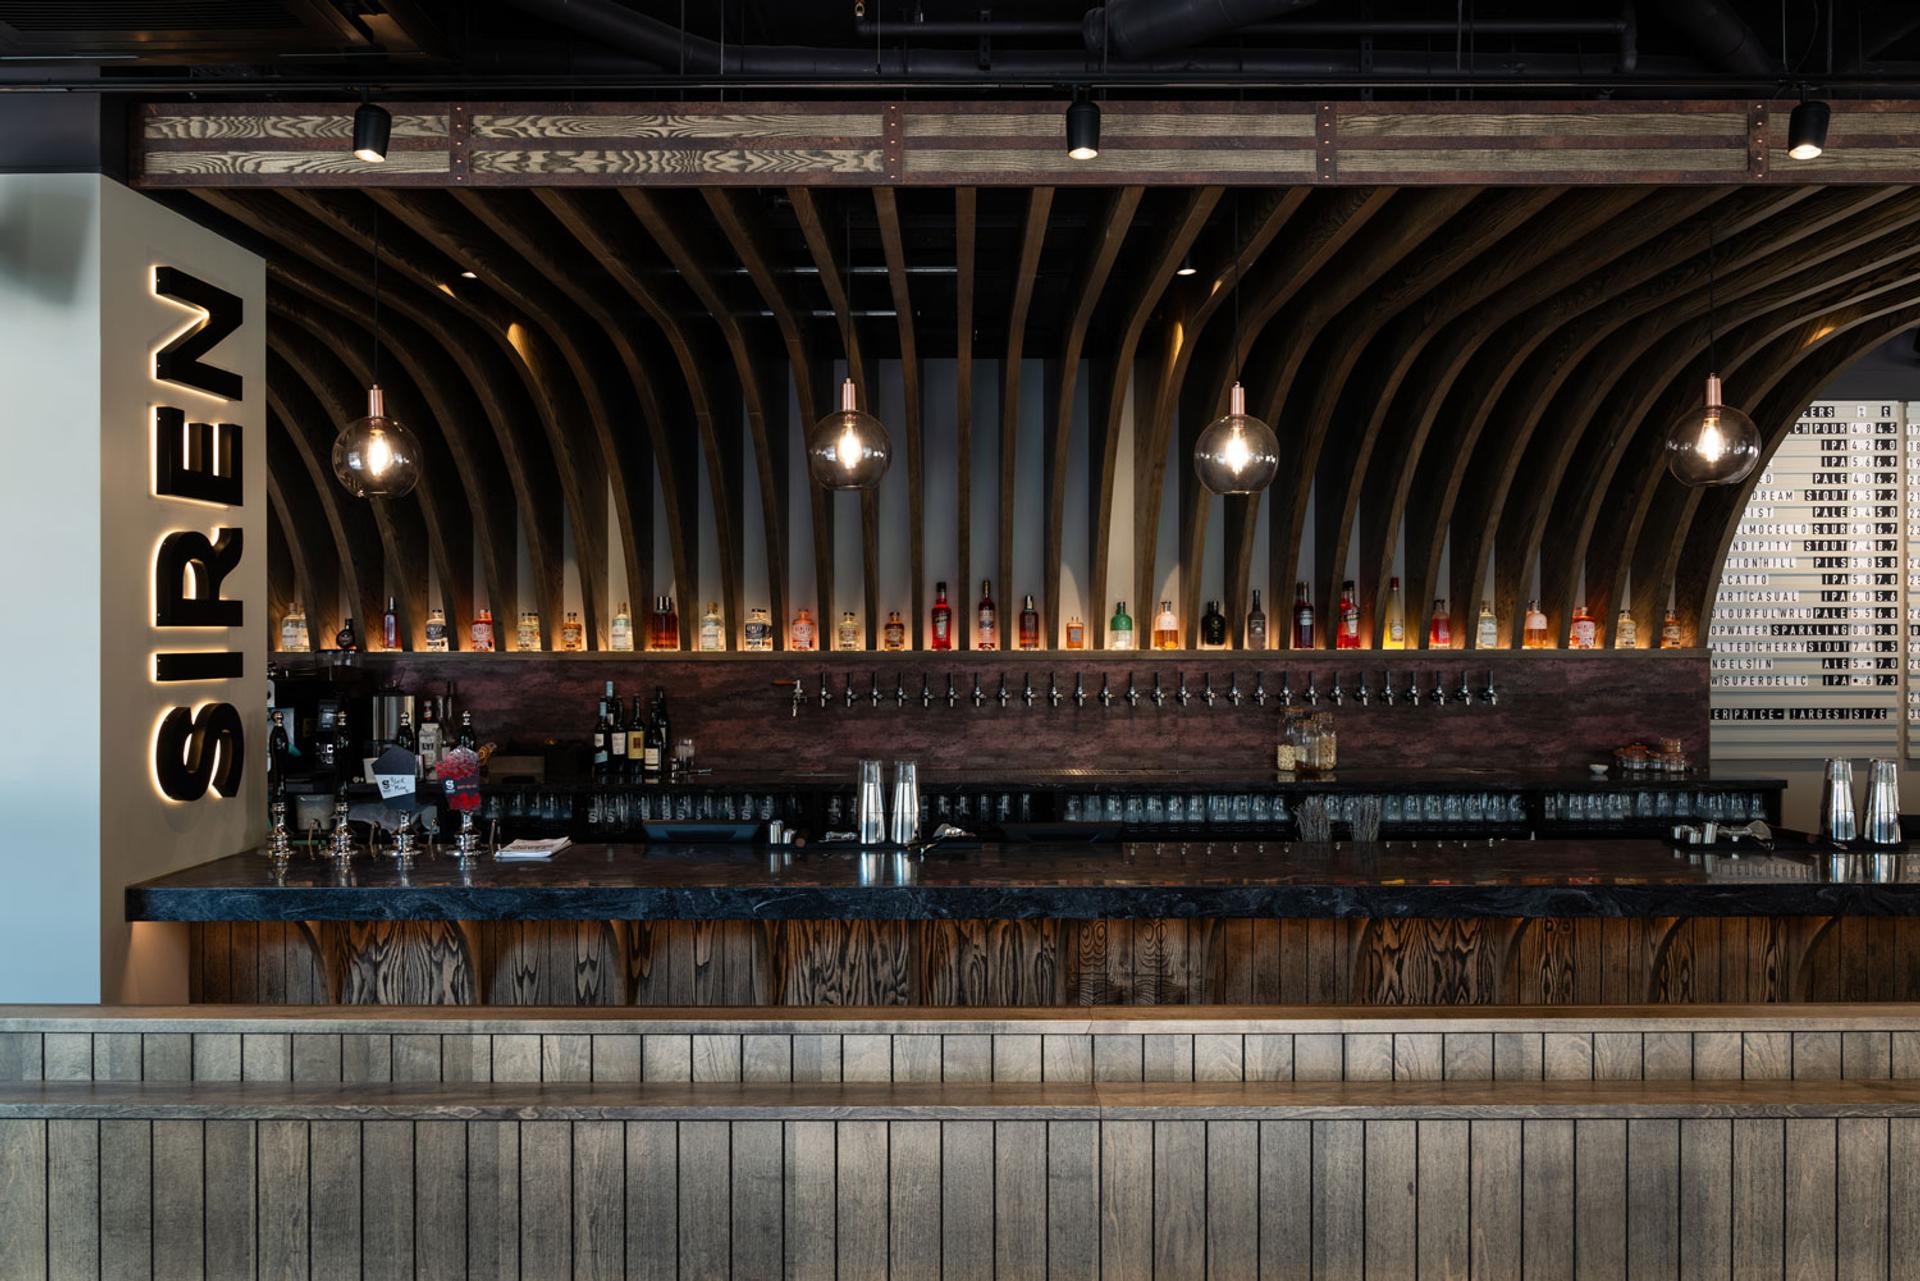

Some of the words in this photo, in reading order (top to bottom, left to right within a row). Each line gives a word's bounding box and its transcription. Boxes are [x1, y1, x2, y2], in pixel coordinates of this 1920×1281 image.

[1814, 424, 1846, 433] POUR
[1877, 424, 1896, 433] 4.5
[1824, 441, 1846, 450] IPA
[1824, 457, 1846, 466] IPA
[1876, 457, 1895, 466] 6.9
[1814, 474, 1847, 483] PALE
[1876, 474, 1896, 483] 6.2
[1806, 491, 1847, 500] STOUT
[1877, 491, 1896, 500] 7.2
[1814, 507, 1847, 516] PALE
[1877, 507, 1896, 516] 5.0
[1814, 524, 1846, 533] SOUR
[1877, 524, 1896, 533] 6.7
[154, 265, 244, 802] SIREN
[1806, 541, 1846, 550] STOUT
[1815, 558, 1847, 567] PILS
[1824, 575, 1847, 584] IPA
[1877, 575, 1896, 584] 7.0
[1719, 592, 1742, 601] ART
[1748, 592, 1796, 601] CASUAL
[1824, 592, 1846, 601] IPA
[1877, 592, 1896, 601] 5.6
[1815, 608, 1846, 618] PALE
[1878, 608, 1896, 618] 6.8
[1772, 625, 1847, 635] SPARKLING
[1878, 625, 1896, 635] 3.8
[1712, 642, 1750, 652] ALTED
[1758, 642, 1805, 652] CHERRY
[1808, 642, 1848, 652] STOUT
[1712, 659, 1752, 668] NGELS
[1824, 659, 1848, 668] ALE
[1878, 659, 1896, 668] 7.0
[1724, 675, 1806, 685] SUPERDELIC
[1825, 675, 1848, 685] IPA
[1878, 675, 1896, 685] 7.3
[1714, 709, 1728, 719] ER
[1854, 709, 1886, 719] SIZE
